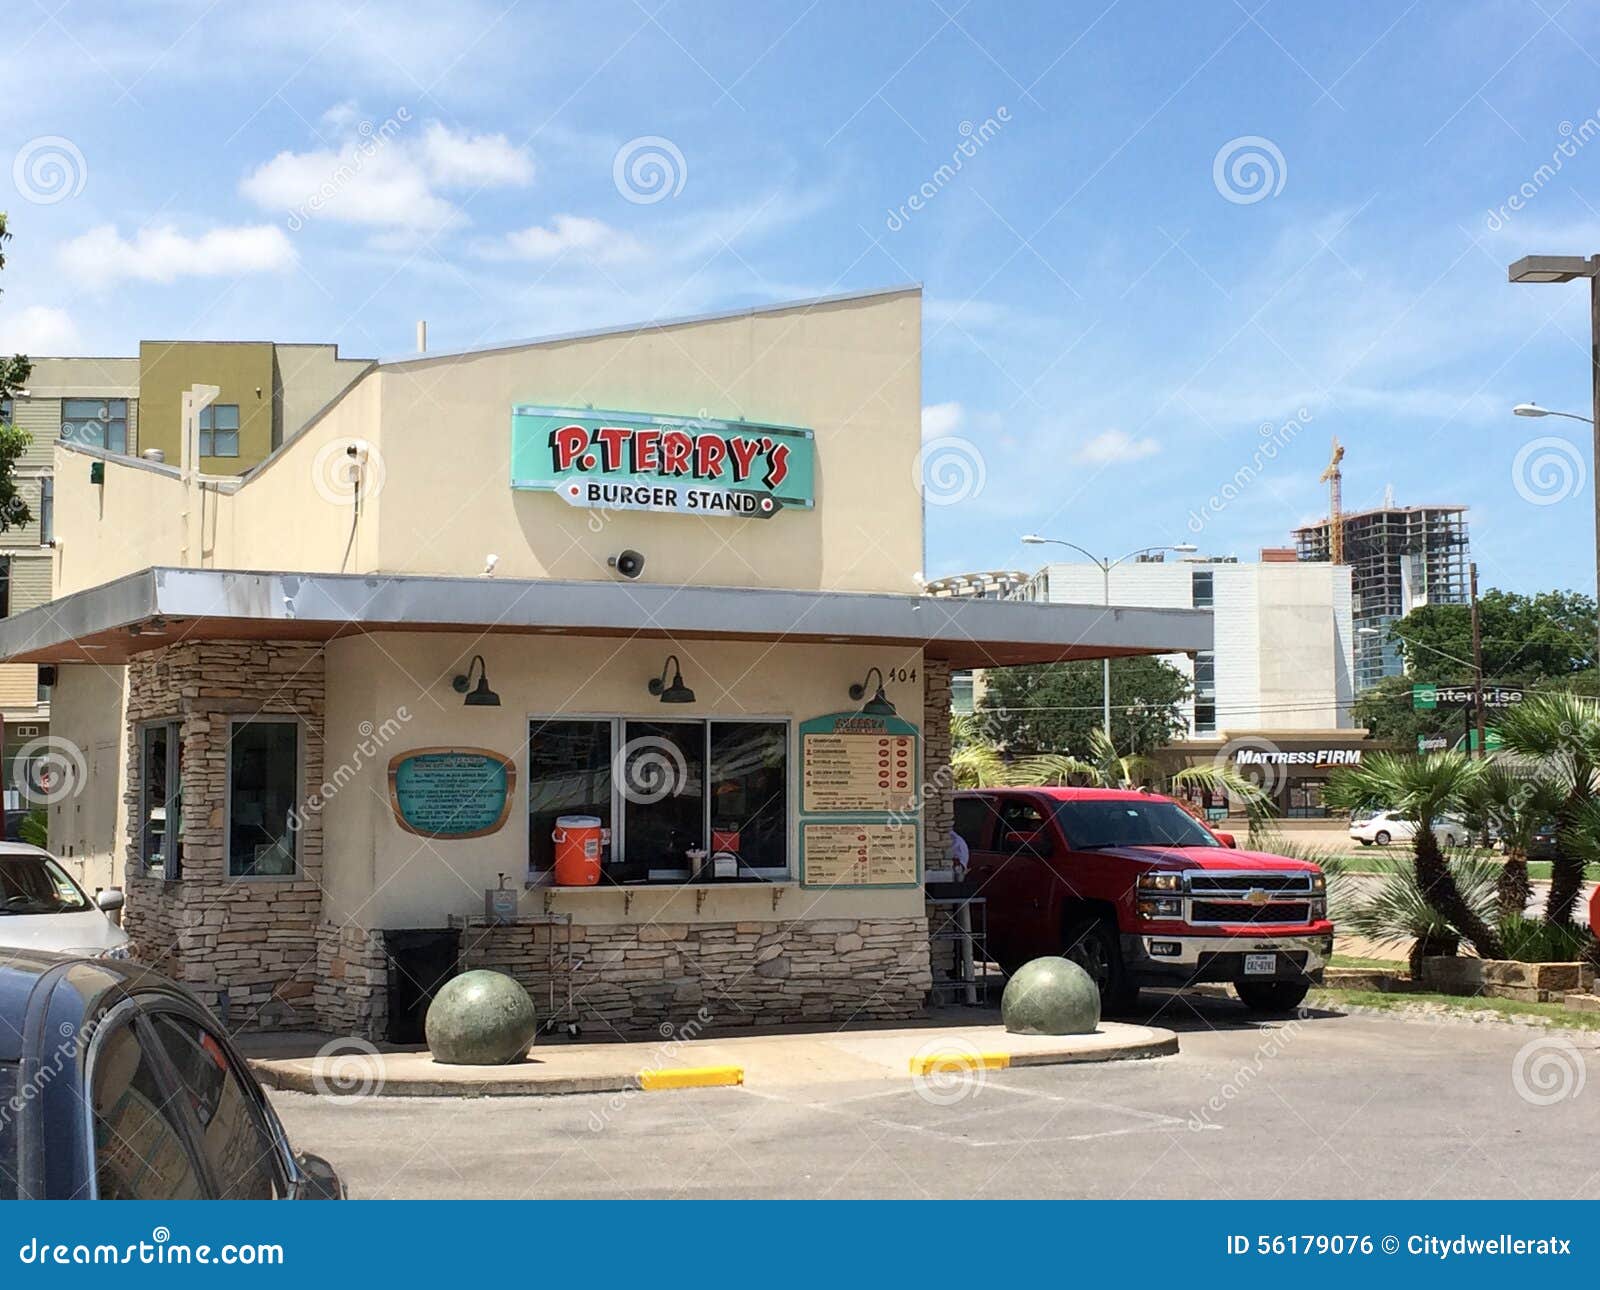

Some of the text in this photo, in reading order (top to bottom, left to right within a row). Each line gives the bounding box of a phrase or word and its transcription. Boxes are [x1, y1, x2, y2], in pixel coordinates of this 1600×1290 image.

[548, 425, 790, 489] P.TERRY'S
[587, 483, 756, 513] BURGER STAND
[889, 667, 916, 683] 404
